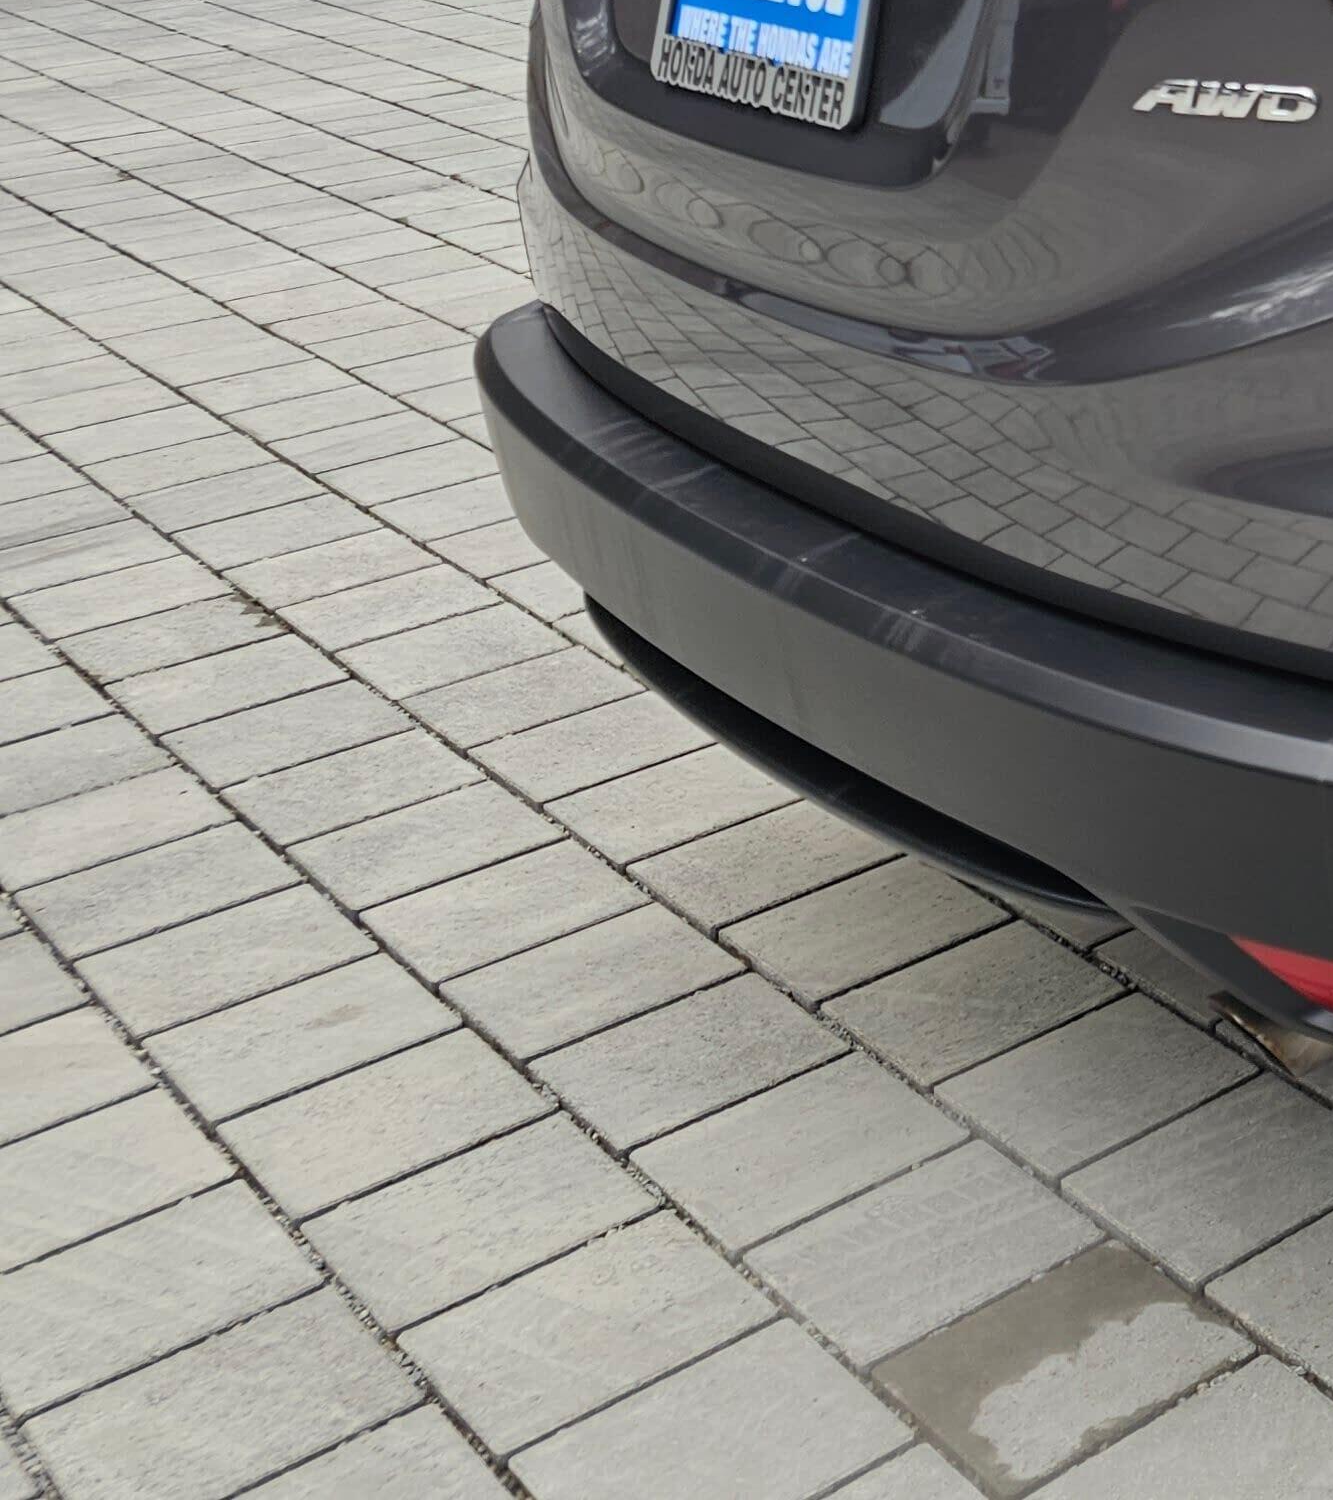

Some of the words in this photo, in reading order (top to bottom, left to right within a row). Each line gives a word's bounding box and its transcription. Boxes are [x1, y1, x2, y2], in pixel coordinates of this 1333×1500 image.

[677, 4, 728, 48] WHERE
[729, 15, 757, 53] THE
[817, 37, 853, 78] ARE
[658, 38, 714, 91] HONDA
[718, 56, 767, 104] AUTO
[772, 67, 846, 125] CENTER
[1132, 79, 1316, 122] AWD
